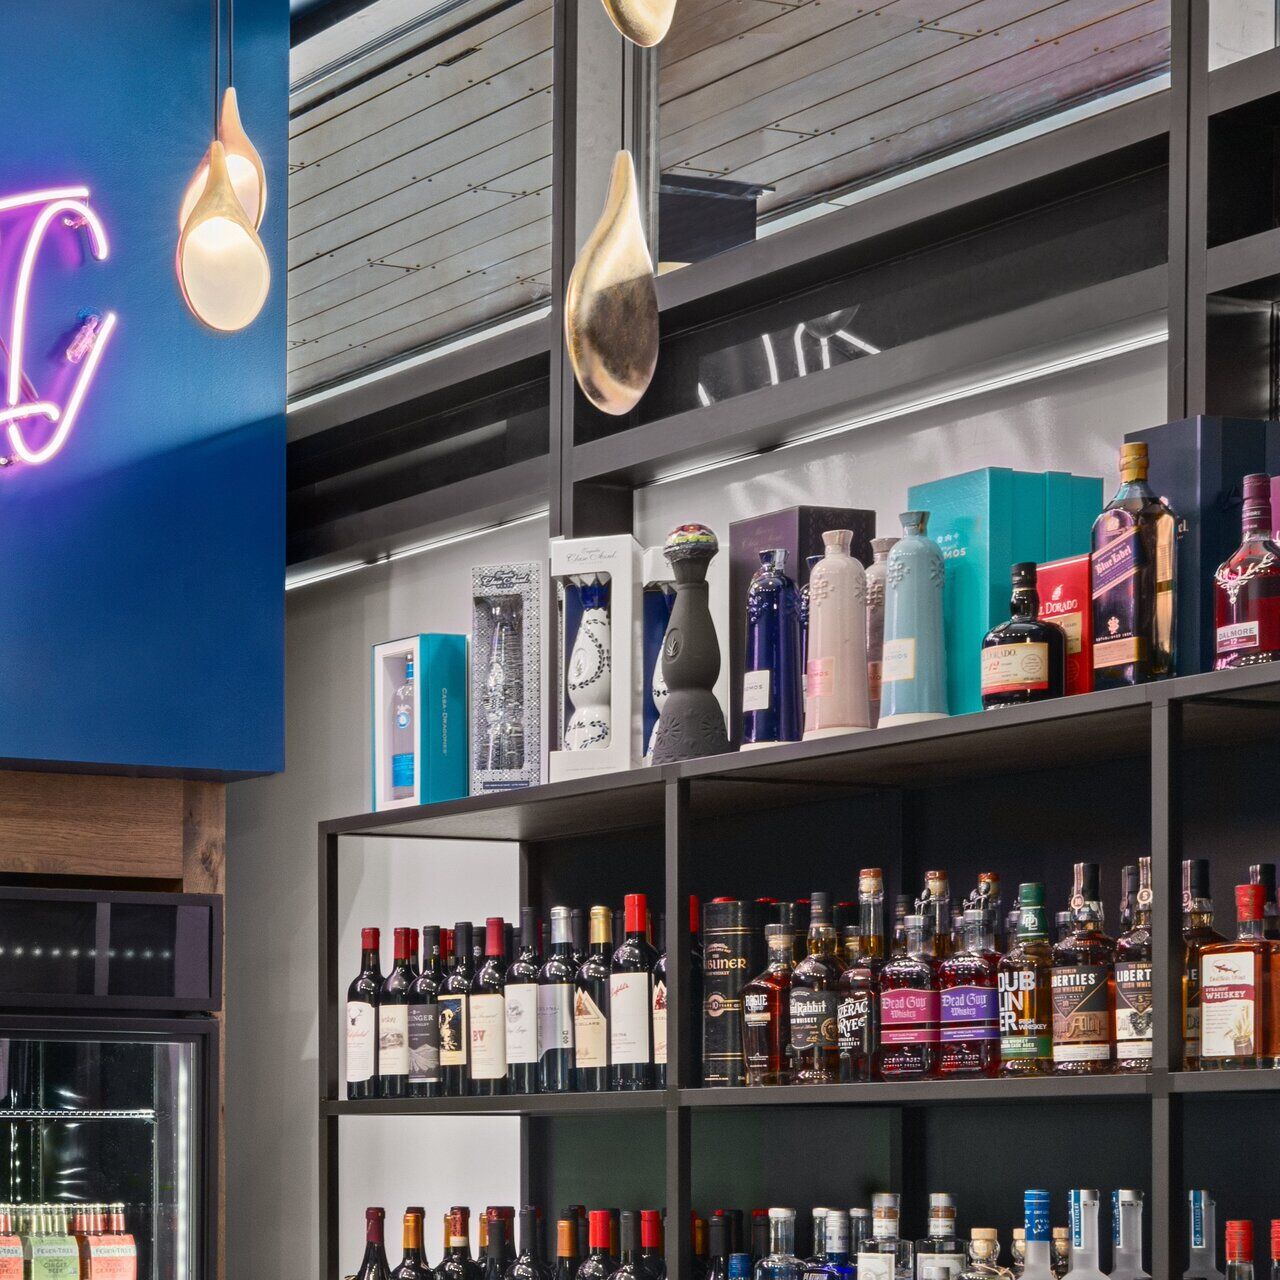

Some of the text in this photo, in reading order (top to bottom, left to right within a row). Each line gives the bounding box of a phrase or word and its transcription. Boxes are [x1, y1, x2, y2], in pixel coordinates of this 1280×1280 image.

[1095, 545, 1132, 576] Blue Label
[1046, 599, 1079, 615] DORADO
[1219, 627, 1255, 641] DALMORE
[1117, 969, 1152, 982] LIBERT
[1060, 985, 1086, 993] WHISKEY
[1205, 990, 1247, 1000] WHISKEY
[745, 994, 768, 1006] ROGUE
[882, 995, 928, 1012] Dead Guy
[942, 993, 988, 1008] Dead Guy
[1000, 1012, 1018, 1031] ER
[472, 1030, 486, 1042] BV
